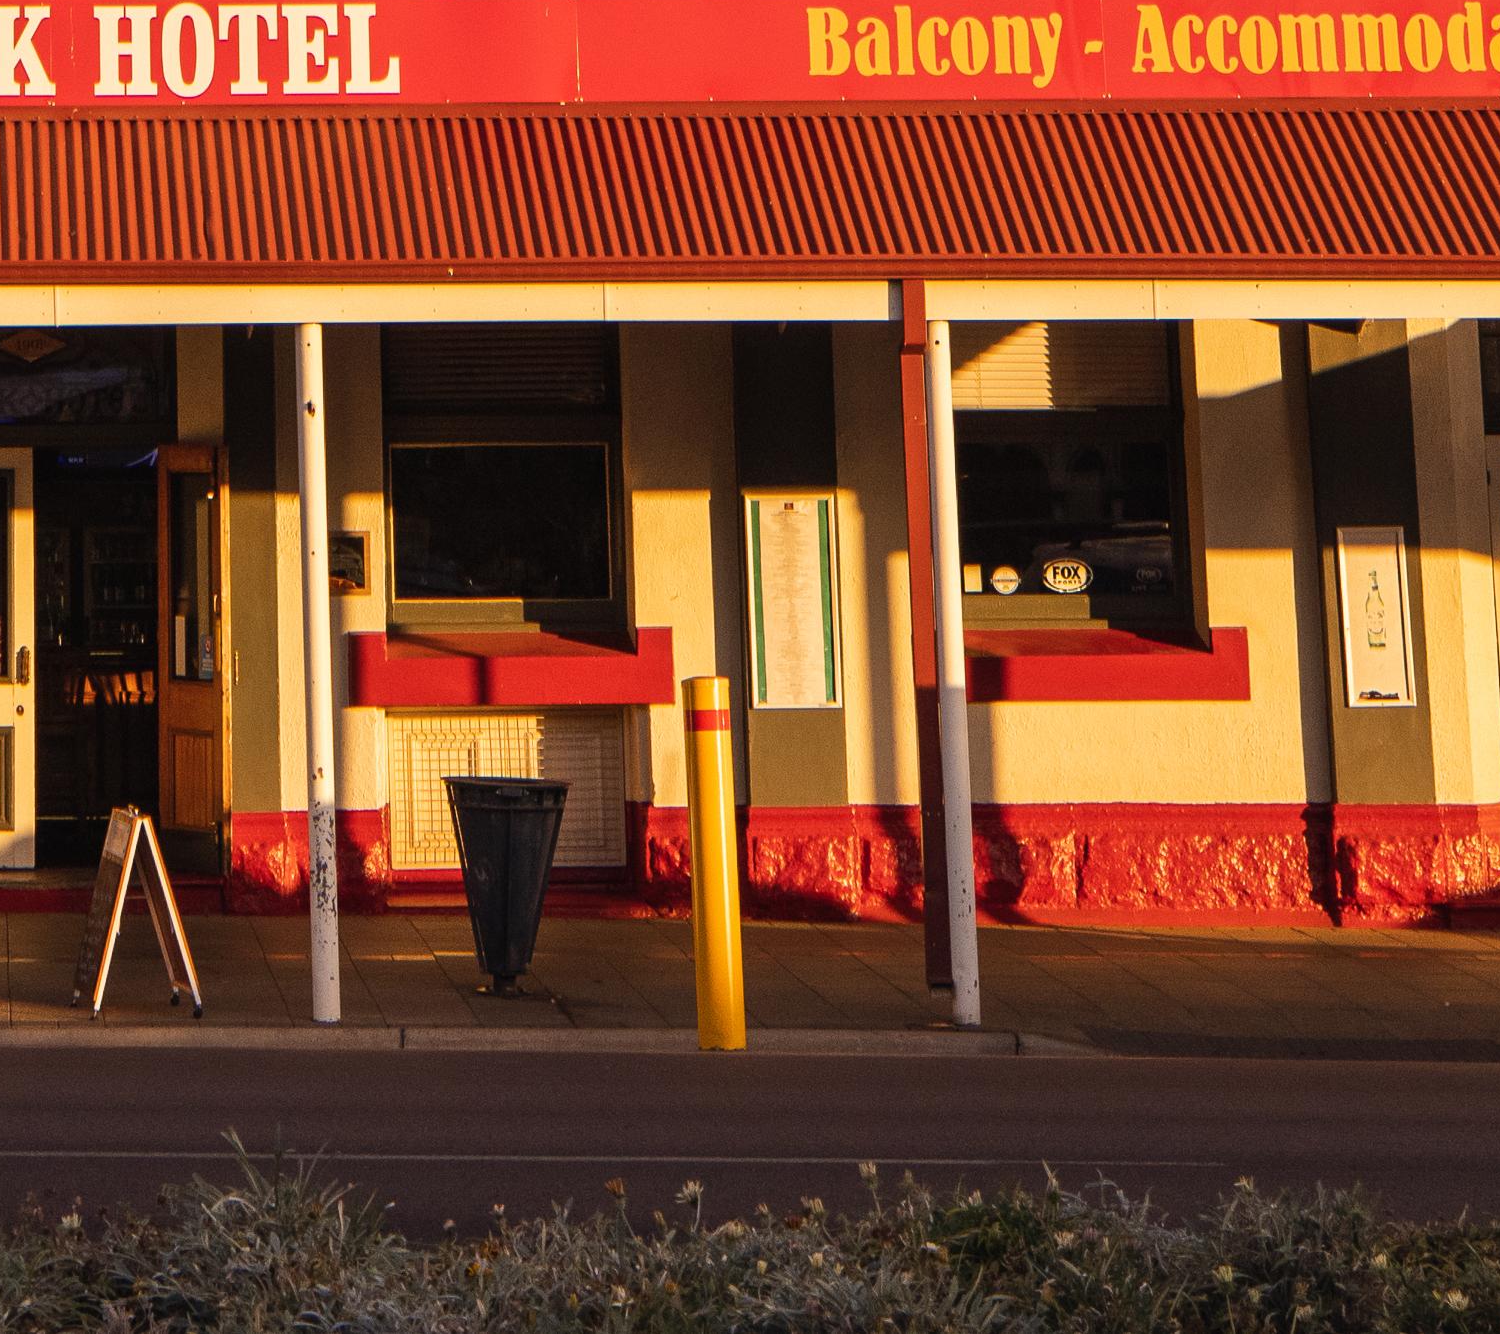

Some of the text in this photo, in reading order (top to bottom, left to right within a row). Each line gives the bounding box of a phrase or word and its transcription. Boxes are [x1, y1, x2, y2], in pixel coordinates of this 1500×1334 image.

[93, 2, 401, 99] HOTEL
[805, 4, 1063, 89] Balcony
[1052, 566, 1081, 580] FOX
